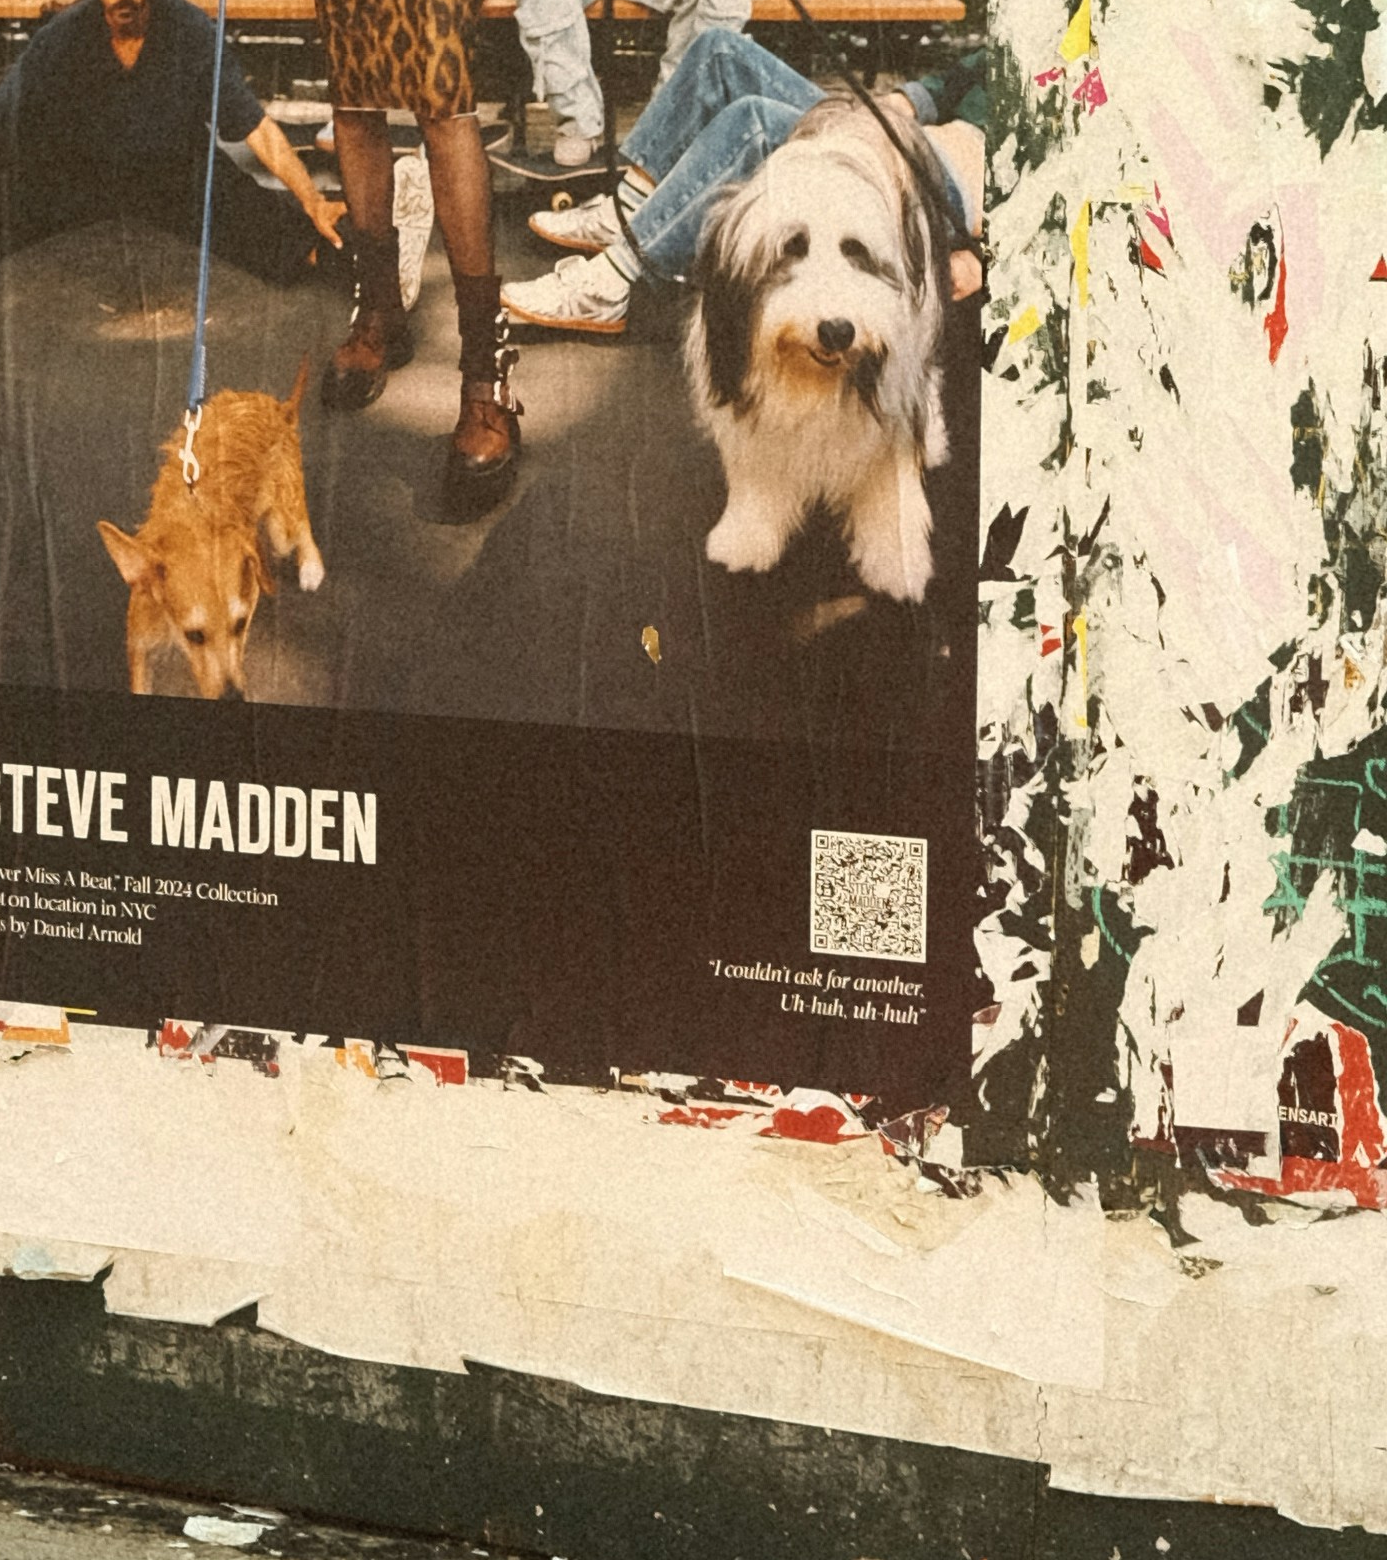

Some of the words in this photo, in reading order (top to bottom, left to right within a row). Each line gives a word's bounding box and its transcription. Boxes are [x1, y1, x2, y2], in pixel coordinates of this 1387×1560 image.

[151, 775, 377, 865] MADDEN
[26, 865, 60, 886] Miss
[64, 869, 76, 887] A
[124, 874, 151, 895] Fall
[155, 878, 192, 898] 2024
[196, 882, 279, 907] Collection
[8, 892, 30, 910] on
[34, 891, 97, 915] location
[101, 898, 117, 918] in
[121, 901, 157, 921] NYC
[10, 916, 29, 939] by
[34, 917, 84, 941] Daniel
[88, 924, 142, 945] Arnold
[724, 961, 791, 983] couldn't
[794, 968, 823, 987] ask
[822, 969, 851, 993] for
